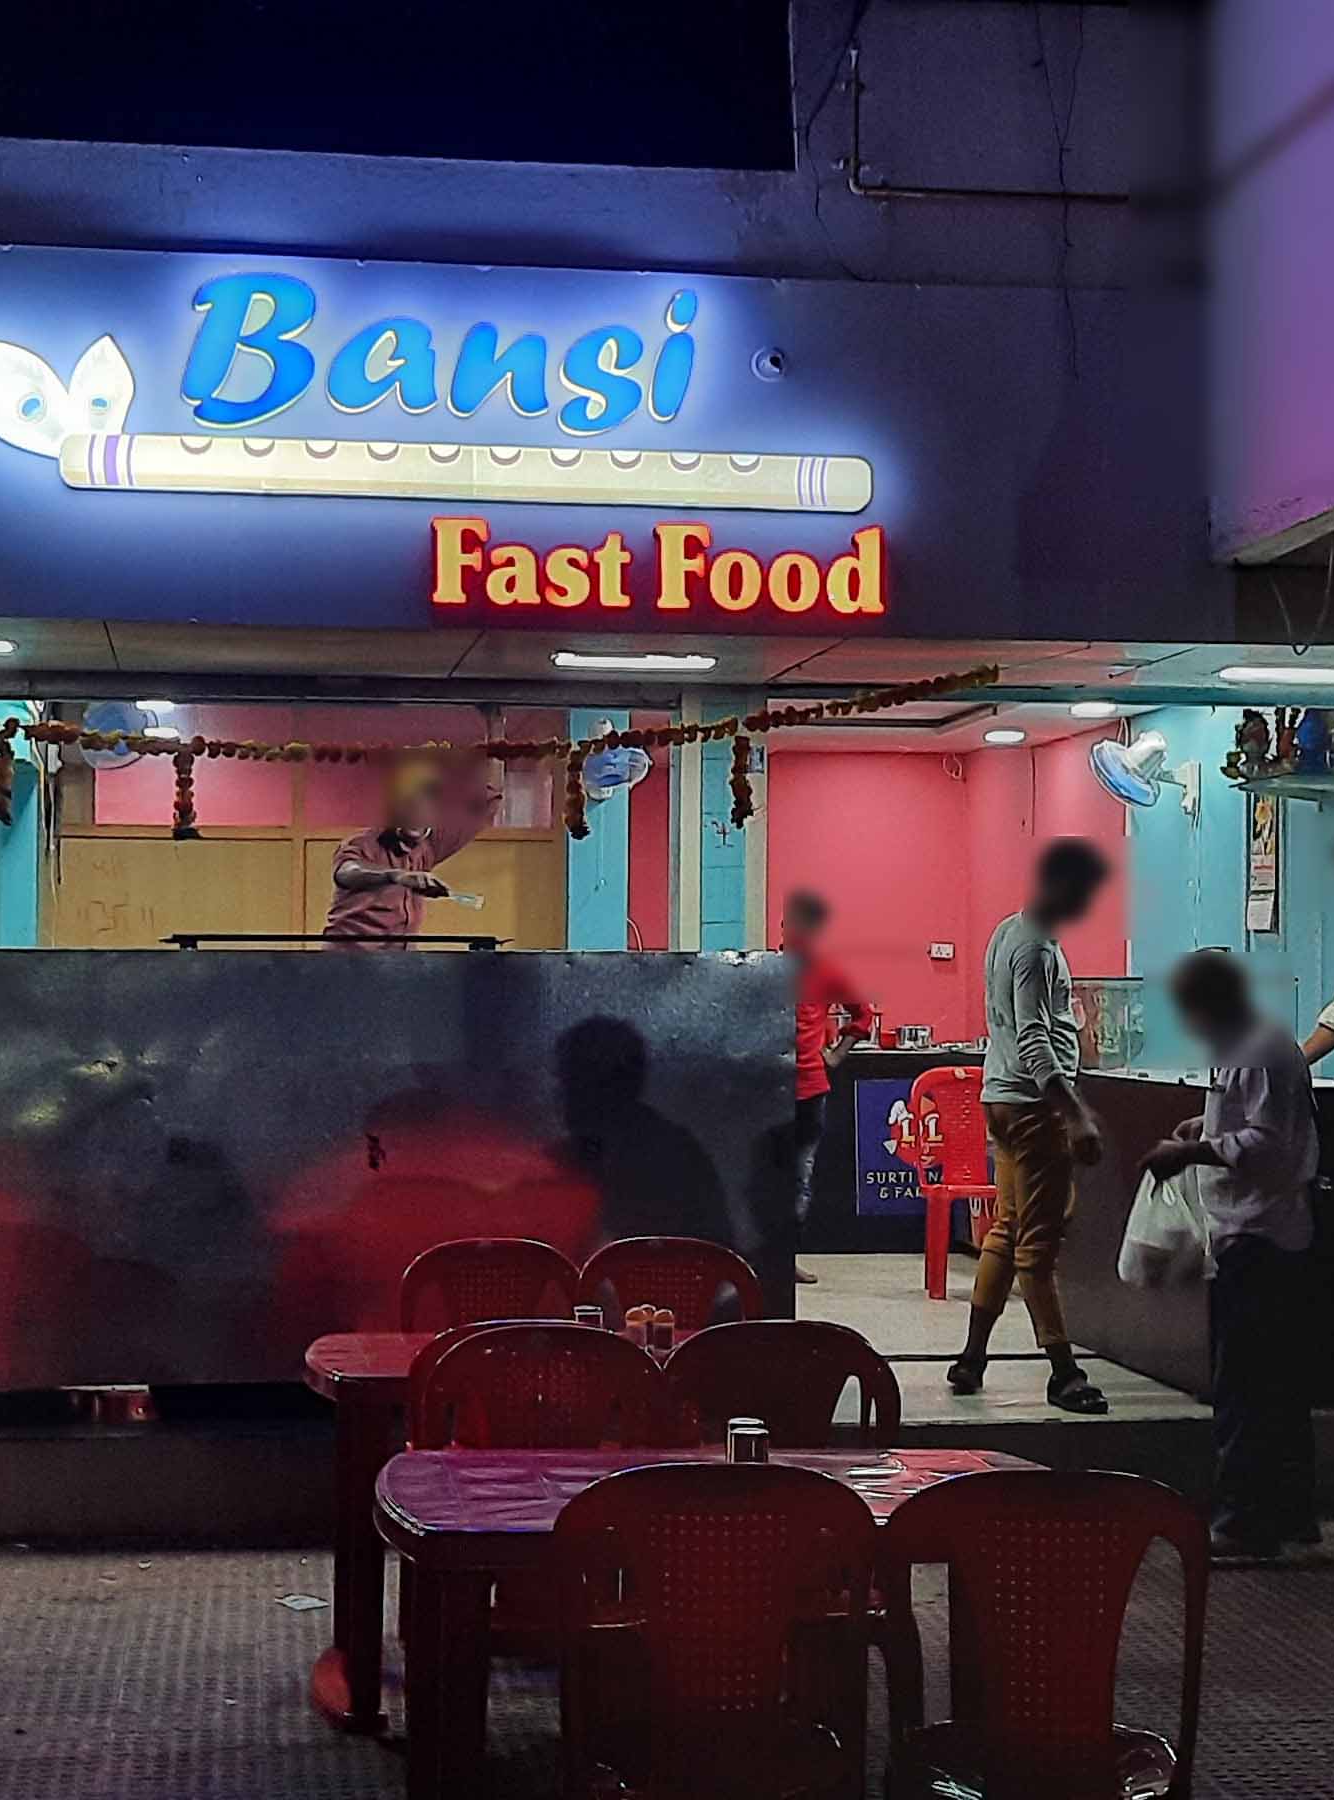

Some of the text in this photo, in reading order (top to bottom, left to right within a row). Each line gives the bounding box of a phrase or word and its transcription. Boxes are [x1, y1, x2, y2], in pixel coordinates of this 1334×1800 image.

[180, 271, 697, 434] Bansi
[429, 515, 888, 616] Fast Food
[866, 1171, 913, 1184] SURTI
